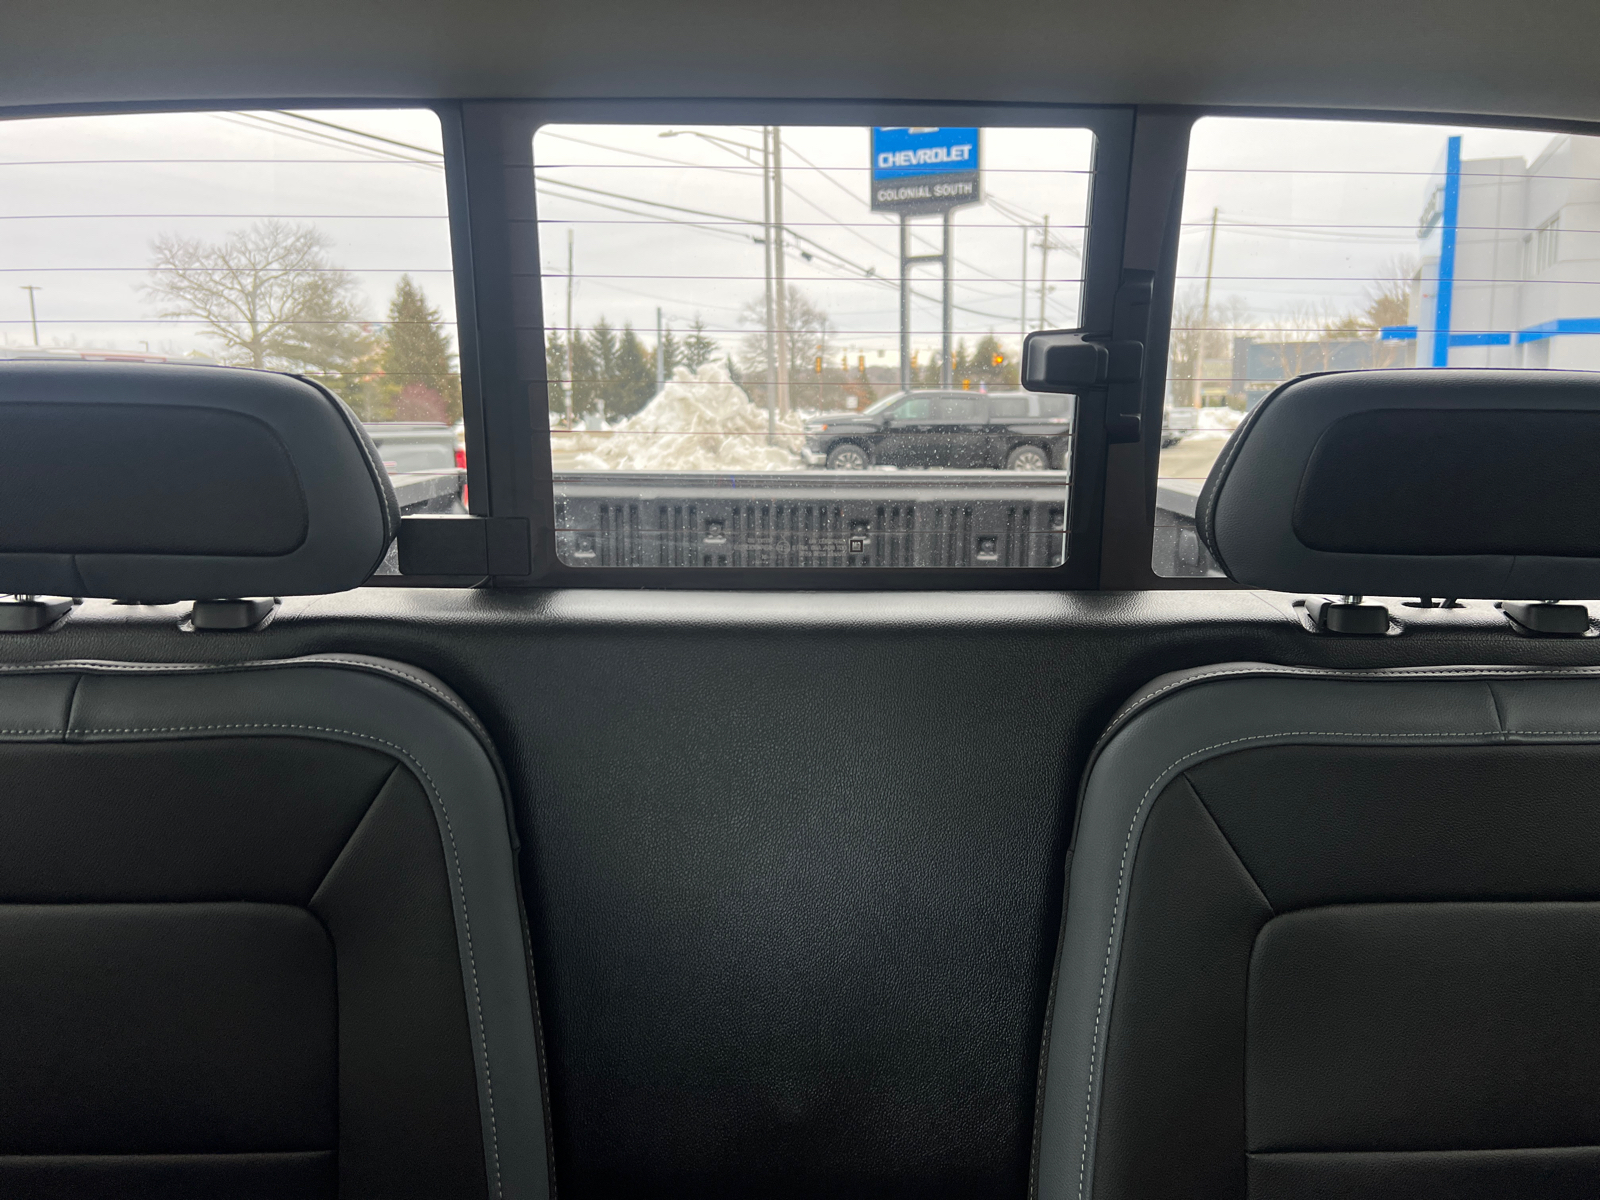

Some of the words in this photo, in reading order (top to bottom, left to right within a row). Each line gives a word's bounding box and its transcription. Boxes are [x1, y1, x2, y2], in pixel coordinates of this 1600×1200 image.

[878, 144, 972, 168] CHEVROLET
[877, 185, 932, 202] COLONIAL
[933, 182, 973, 197] SOUTH
